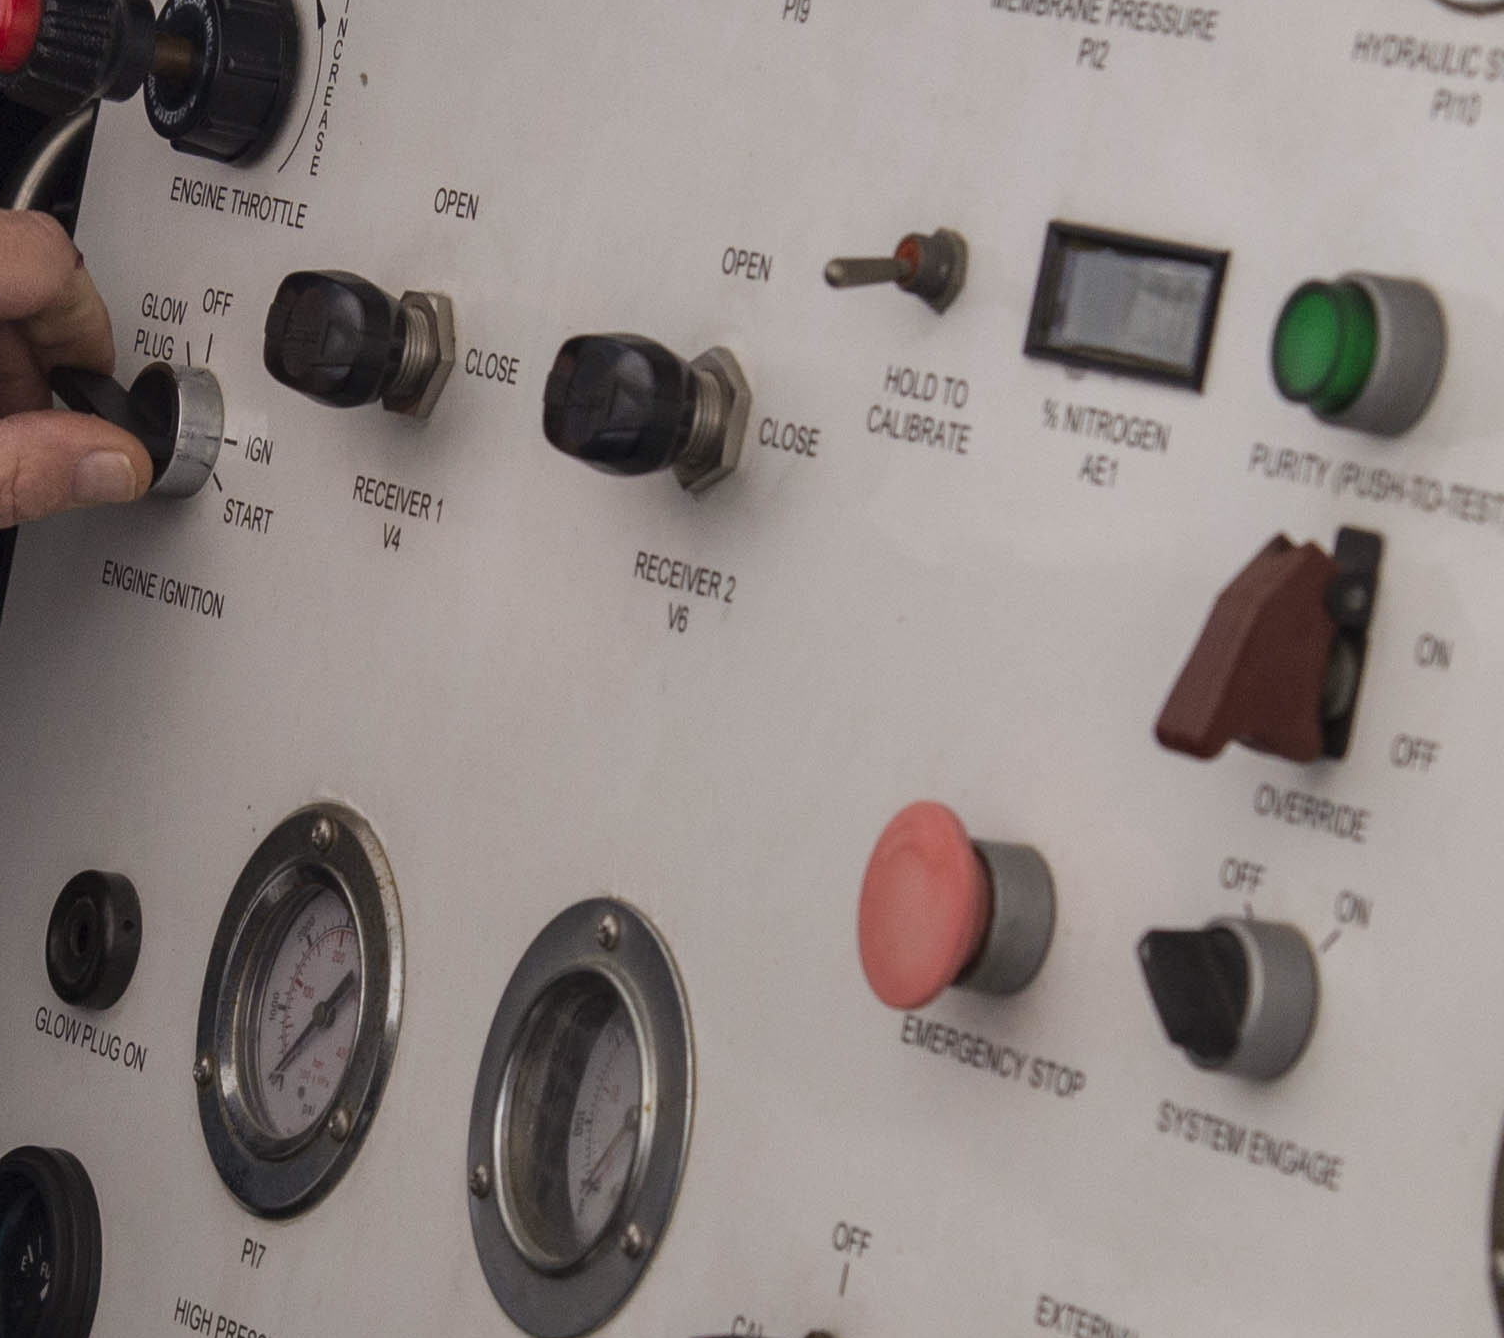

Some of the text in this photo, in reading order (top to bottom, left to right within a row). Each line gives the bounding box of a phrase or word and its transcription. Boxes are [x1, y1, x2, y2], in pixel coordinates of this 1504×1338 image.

[1353, 33, 1481, 78] HYDRAULIC
[170, 176, 308, 230] ENGINE THROTTLE
[434, 187, 480, 221] OPEN
[721, 246, 772, 282] OPEN
[141, 292, 188, 326] GLOW
[202, 287, 234, 316] OFF
[133, 328, 175, 361] PLUG
[464, 348, 520, 385] CLOSE
[885, 366, 969, 410] HOLD TO
[757, 417, 820, 458] CLOSE
[866, 404, 972, 455] CALIBRATE
[1043, 398, 1170, 452] % NITROGEN
[244, 436, 274, 466] IGN
[1249, 442, 1333, 486] PURITY
[223, 498, 274, 534] START
[352, 475, 444, 523] RECEIVER 1
[383, 522, 402, 551] V4
[101, 558, 225, 619] ENGINE IGNITION
[634, 550, 737, 604] RECEIVER 2
[668, 602, 690, 633] V6
[1415, 633, 1451, 669] ON
[1390, 733, 1438, 769] OFF
[1253, 783, 1372, 845] OVERRIDE
[1222, 857, 1265, 890] OFF
[1338, 890, 1370, 926] ON
[35, 1006, 147, 1072] GLOW PLUG ON
[900, 1014, 1085, 1098] EMERGENCY STOP
[1157, 1100, 1341, 1191] SYSTEM ENGAGE
[832, 1221, 872, 1256] OFF
[174, 1297, 214, 1337] HIGH
